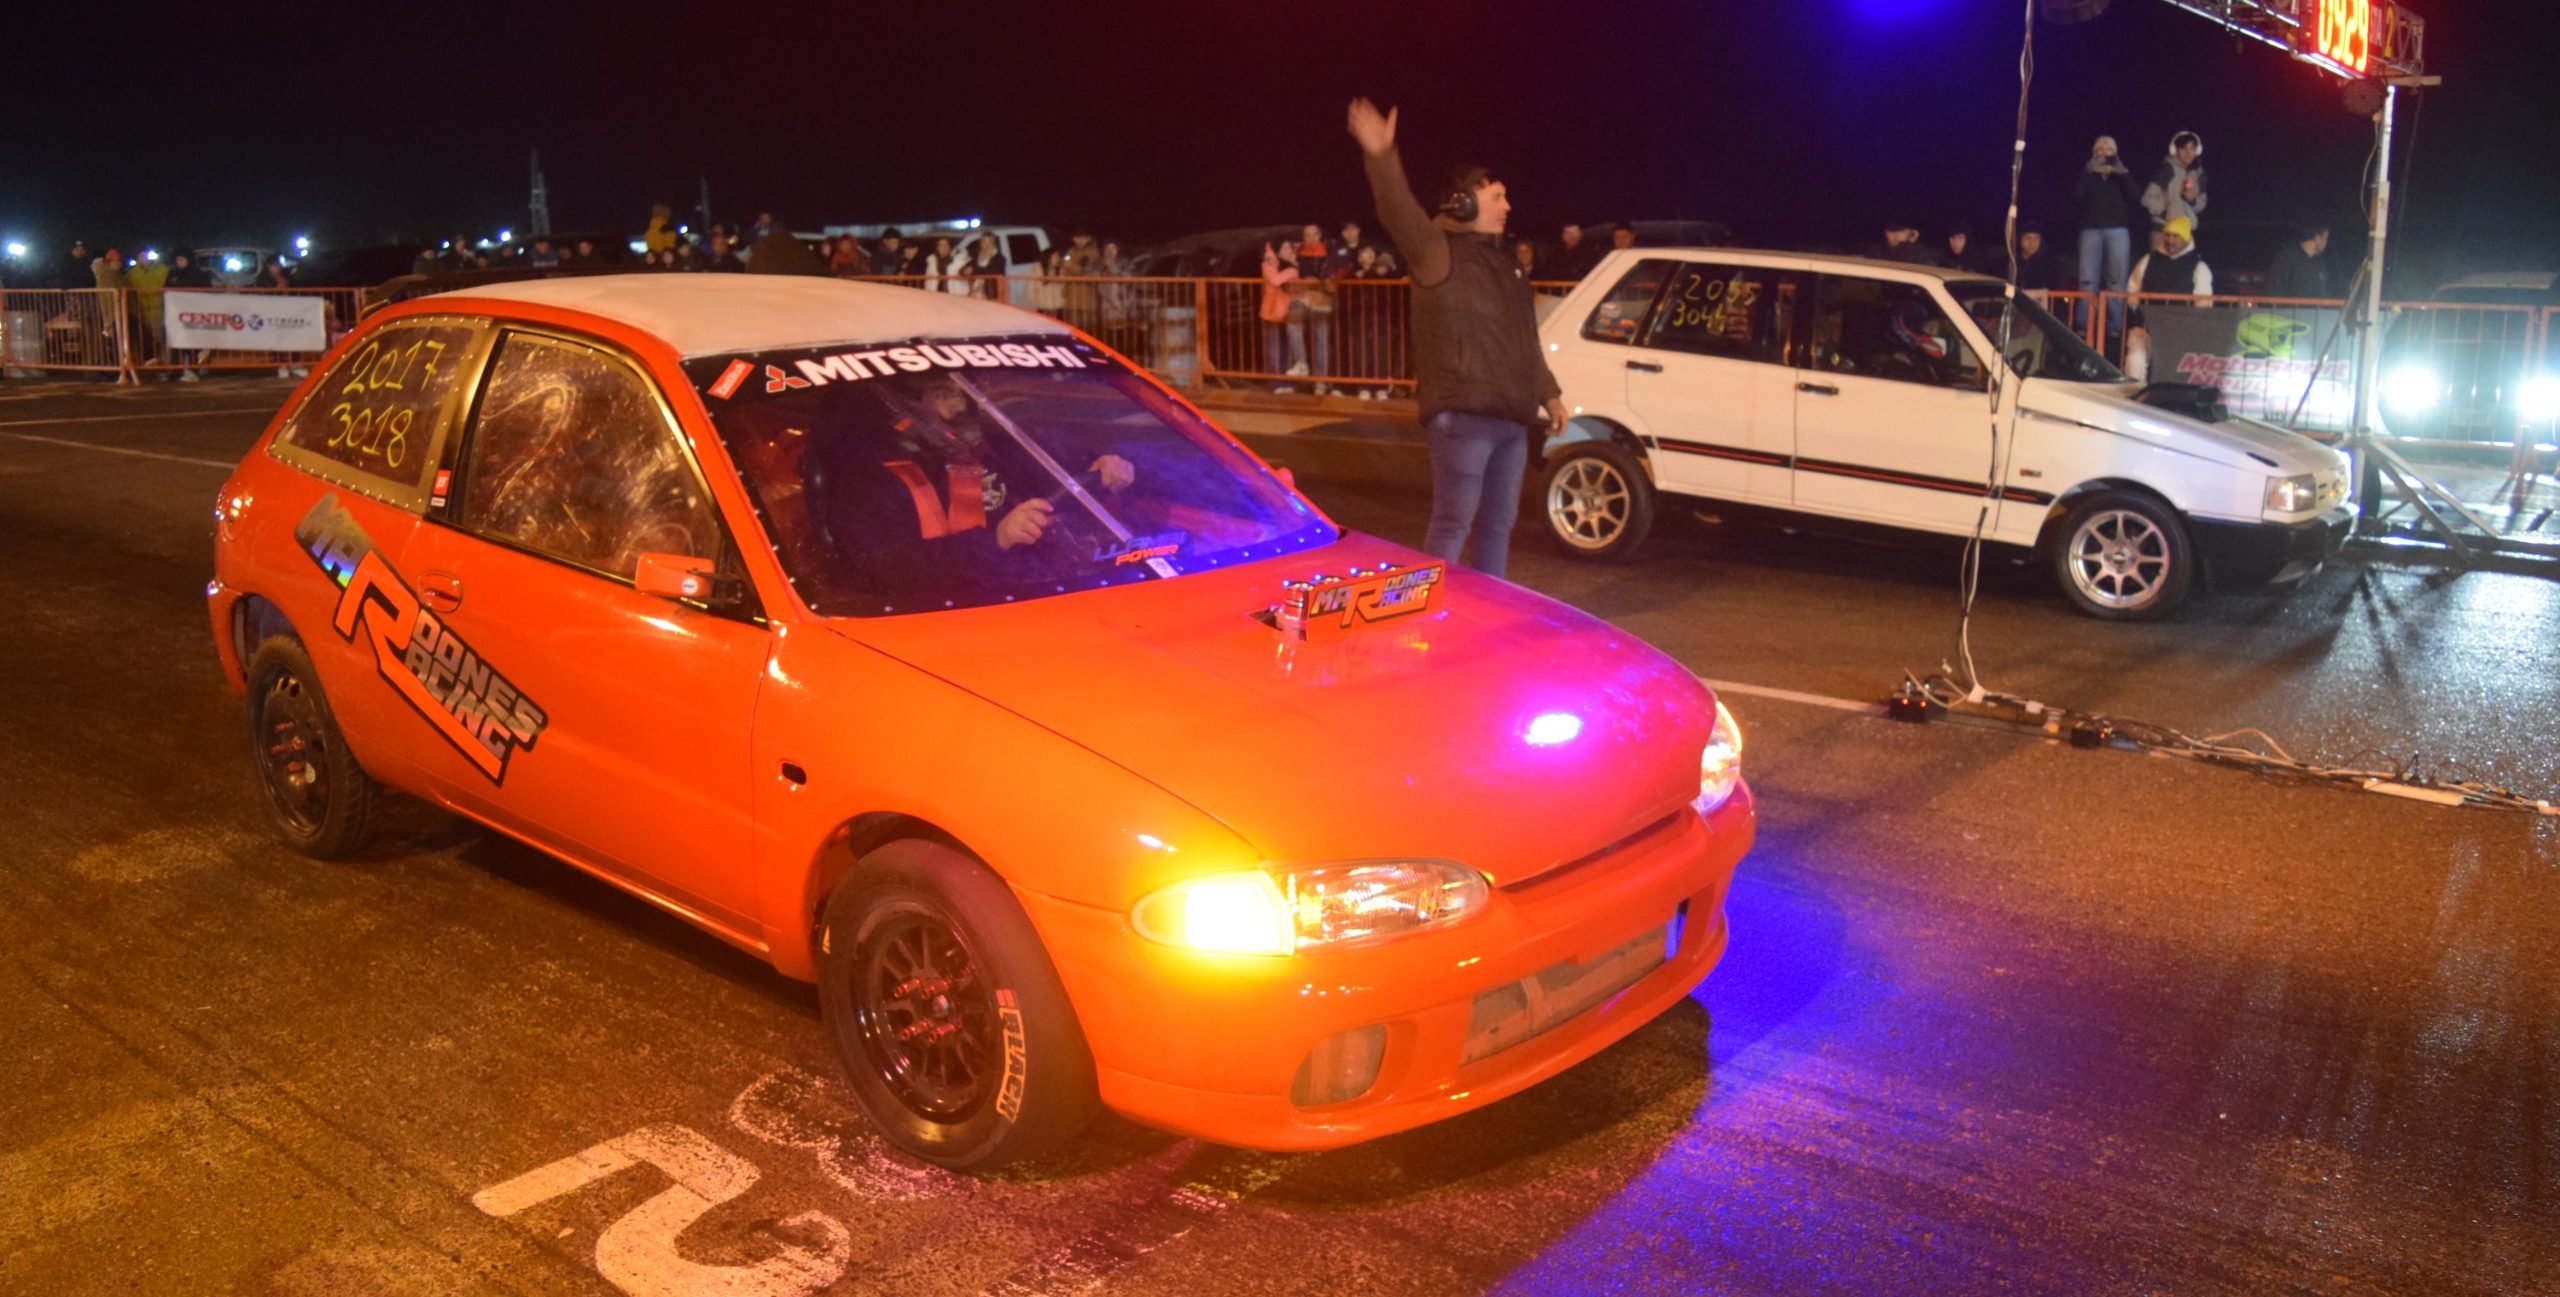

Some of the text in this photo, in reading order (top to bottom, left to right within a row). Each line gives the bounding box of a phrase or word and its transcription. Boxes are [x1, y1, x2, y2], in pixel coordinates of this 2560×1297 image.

[342, 339, 446, 395] 2017
[795, 343, 1087, 387] MITSUBISHI
[327, 402, 413, 468] 3018
[1115, 544, 1179, 567] POWER
